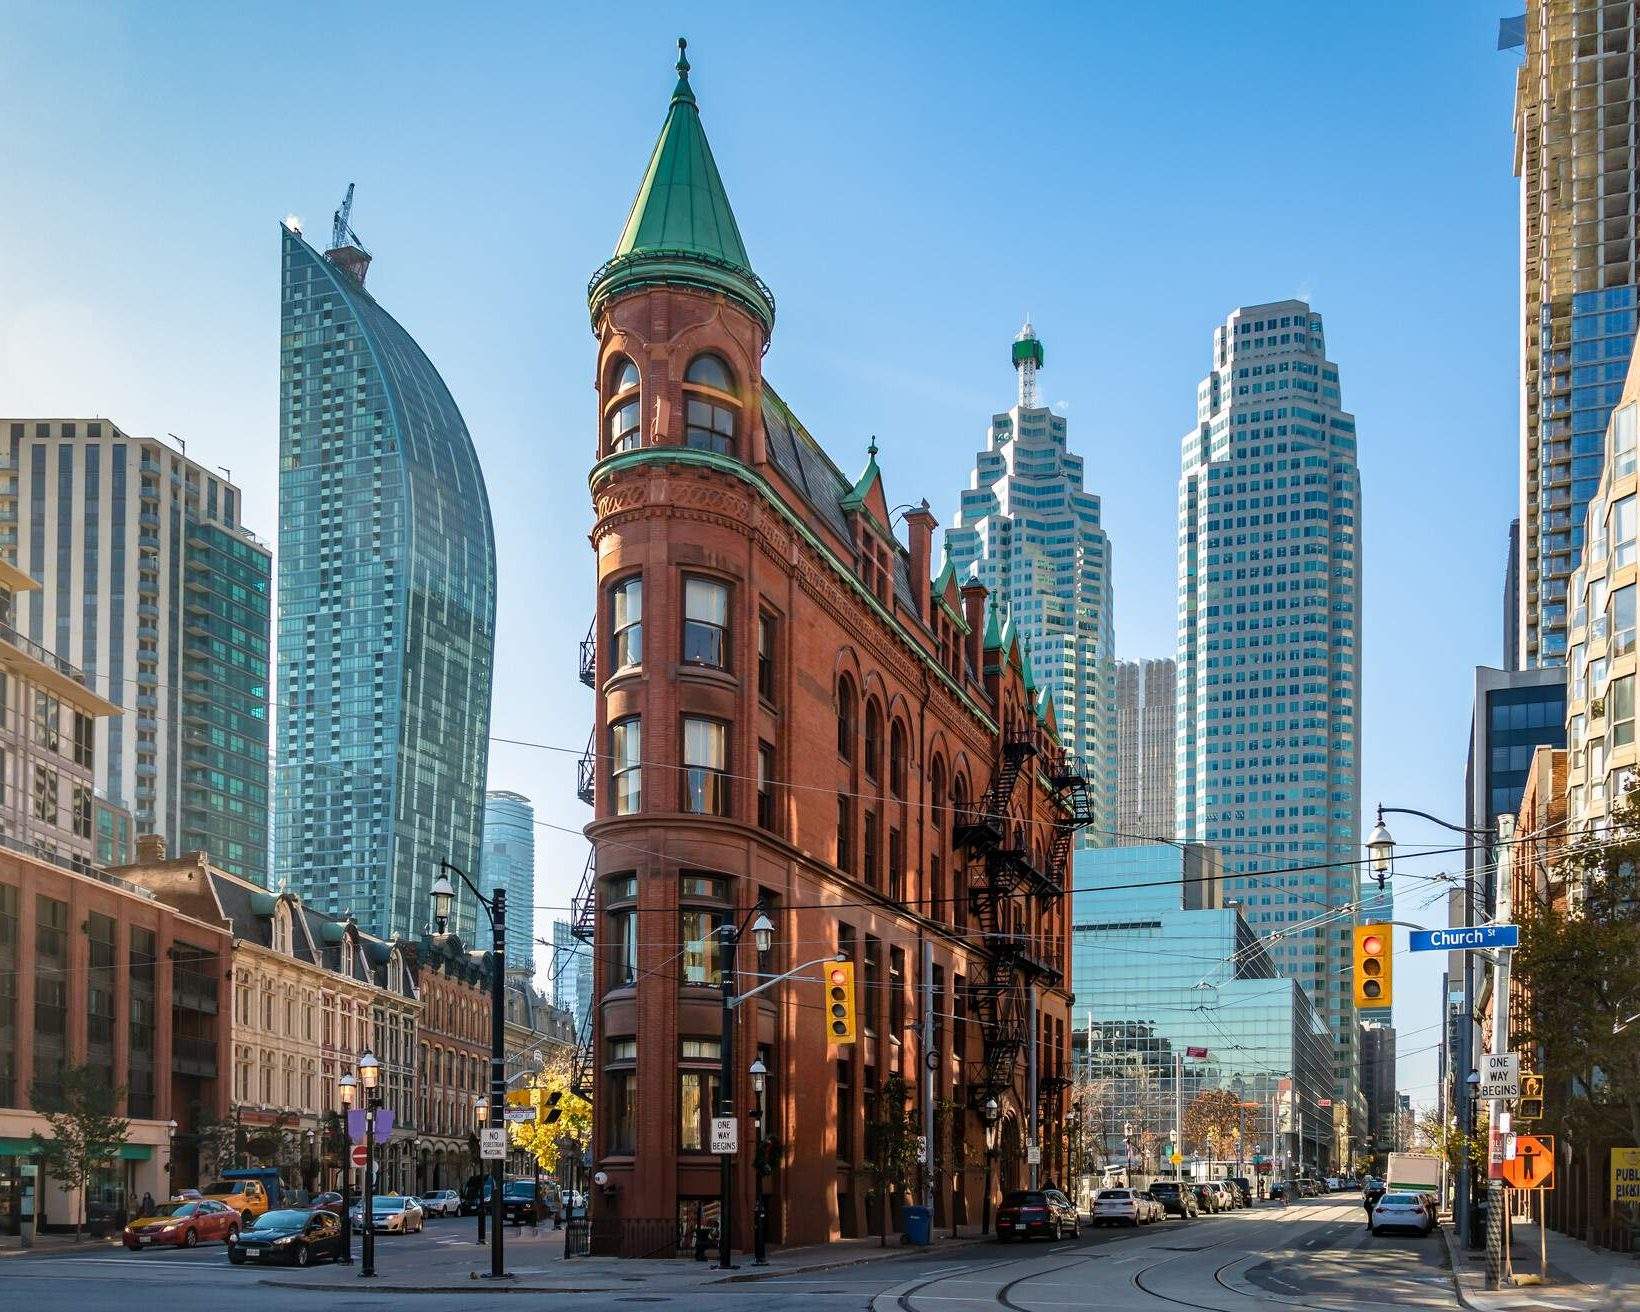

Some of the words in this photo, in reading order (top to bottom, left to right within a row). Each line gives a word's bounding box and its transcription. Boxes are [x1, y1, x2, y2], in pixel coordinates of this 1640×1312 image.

[1431, 929, 1483, 946] Church
[1488, 928, 1496, 937] St
[1490, 1056, 1509, 1068] ONE
[1490, 1071, 1509, 1082] WAY
[1482, 1084, 1518, 1096] BEGINS
[717, 1120, 731, 1129] ONE
[489, 1131, 499, 1140] NO
[717, 1131, 731, 1140] WAY
[712, 1141, 736, 1151] BEGINS
